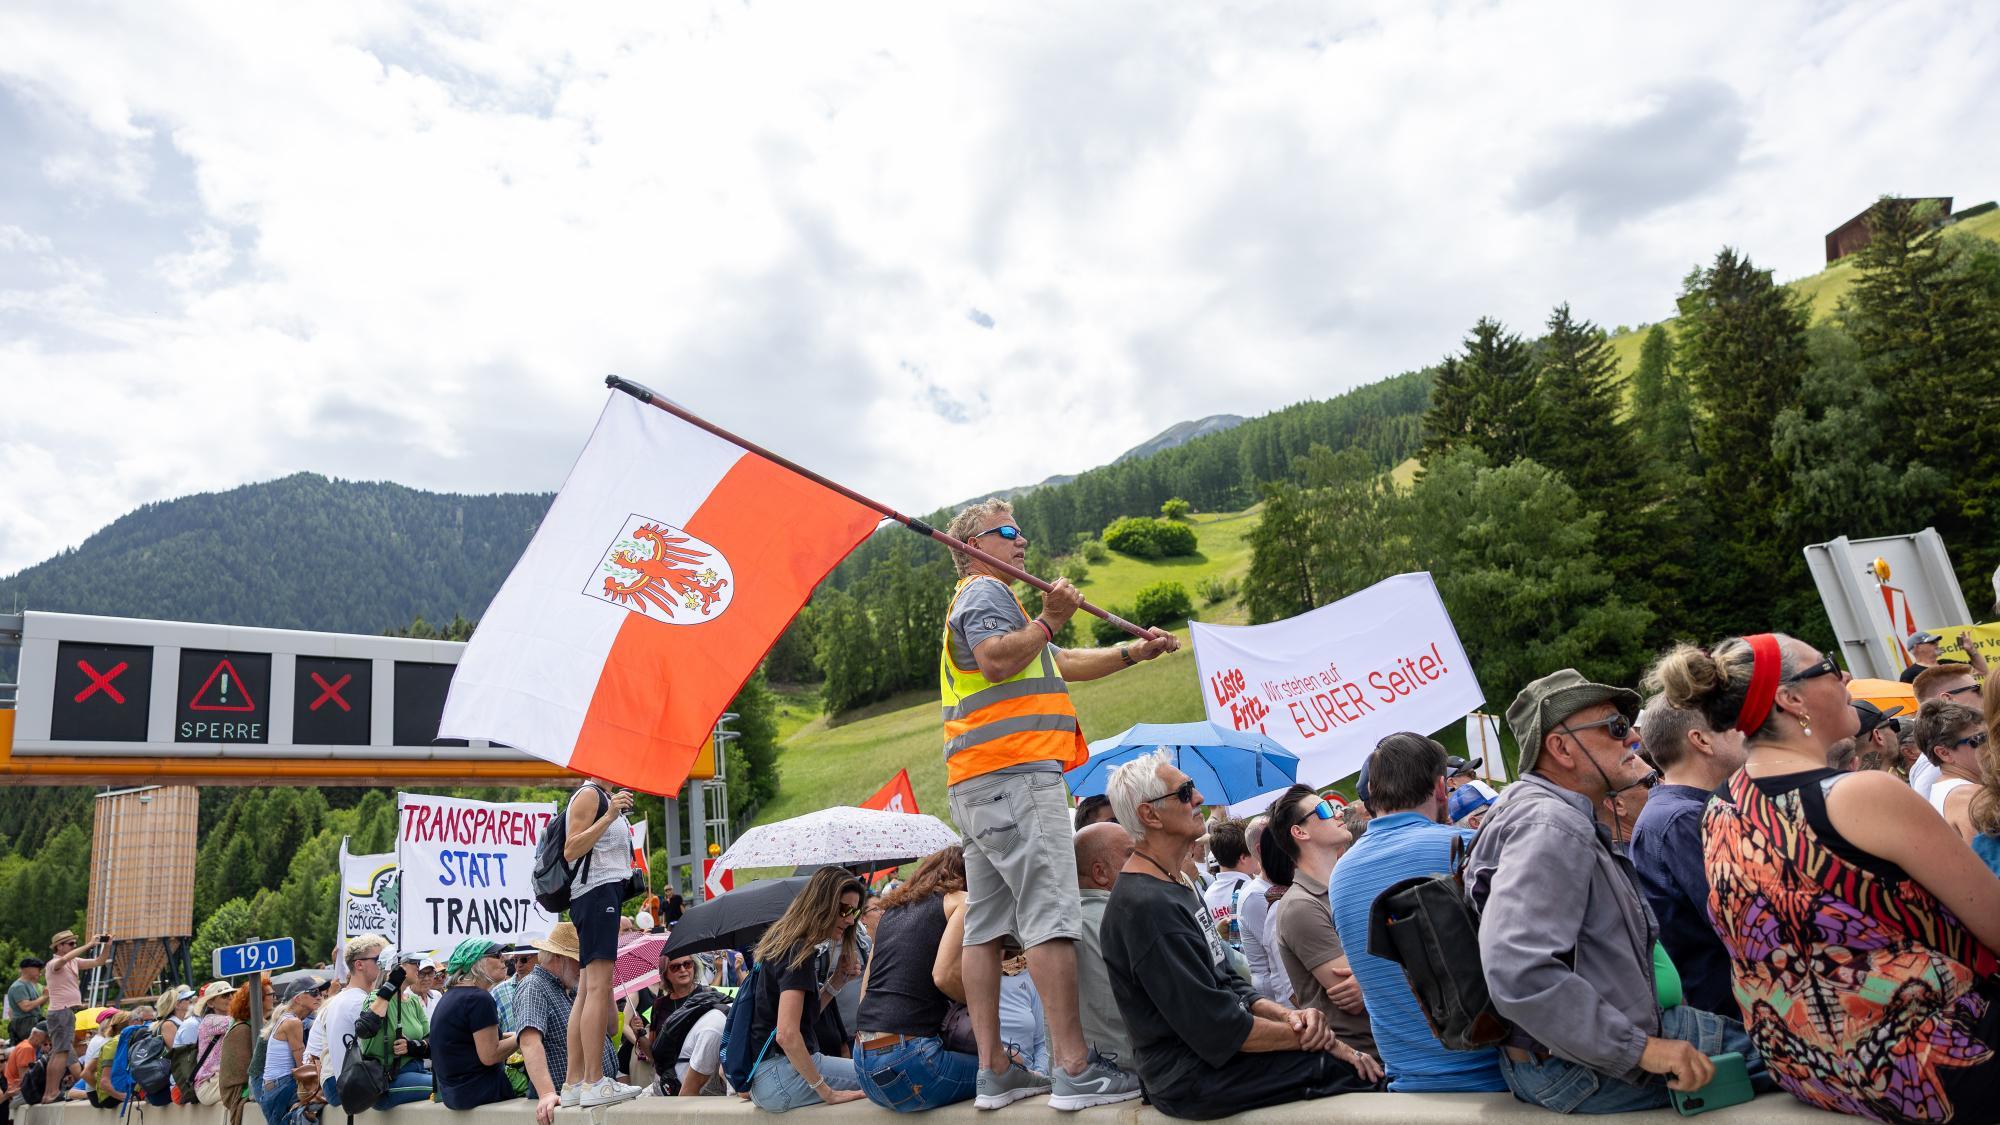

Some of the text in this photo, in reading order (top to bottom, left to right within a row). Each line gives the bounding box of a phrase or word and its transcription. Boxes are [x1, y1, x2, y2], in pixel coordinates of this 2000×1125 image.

[1211, 667, 1245, 707] Liste
[1261, 662, 1343, 702] Wir stehen auf
[1288, 642, 1448, 738] EURER Seite!
[181, 722, 261, 738] SPERRE
[1230, 695, 1270, 731] Fritz.
[439, 850, 508, 888] STATT
[426, 898, 531, 935] TRANSIT
[236, 946, 279, 969] 19,0
